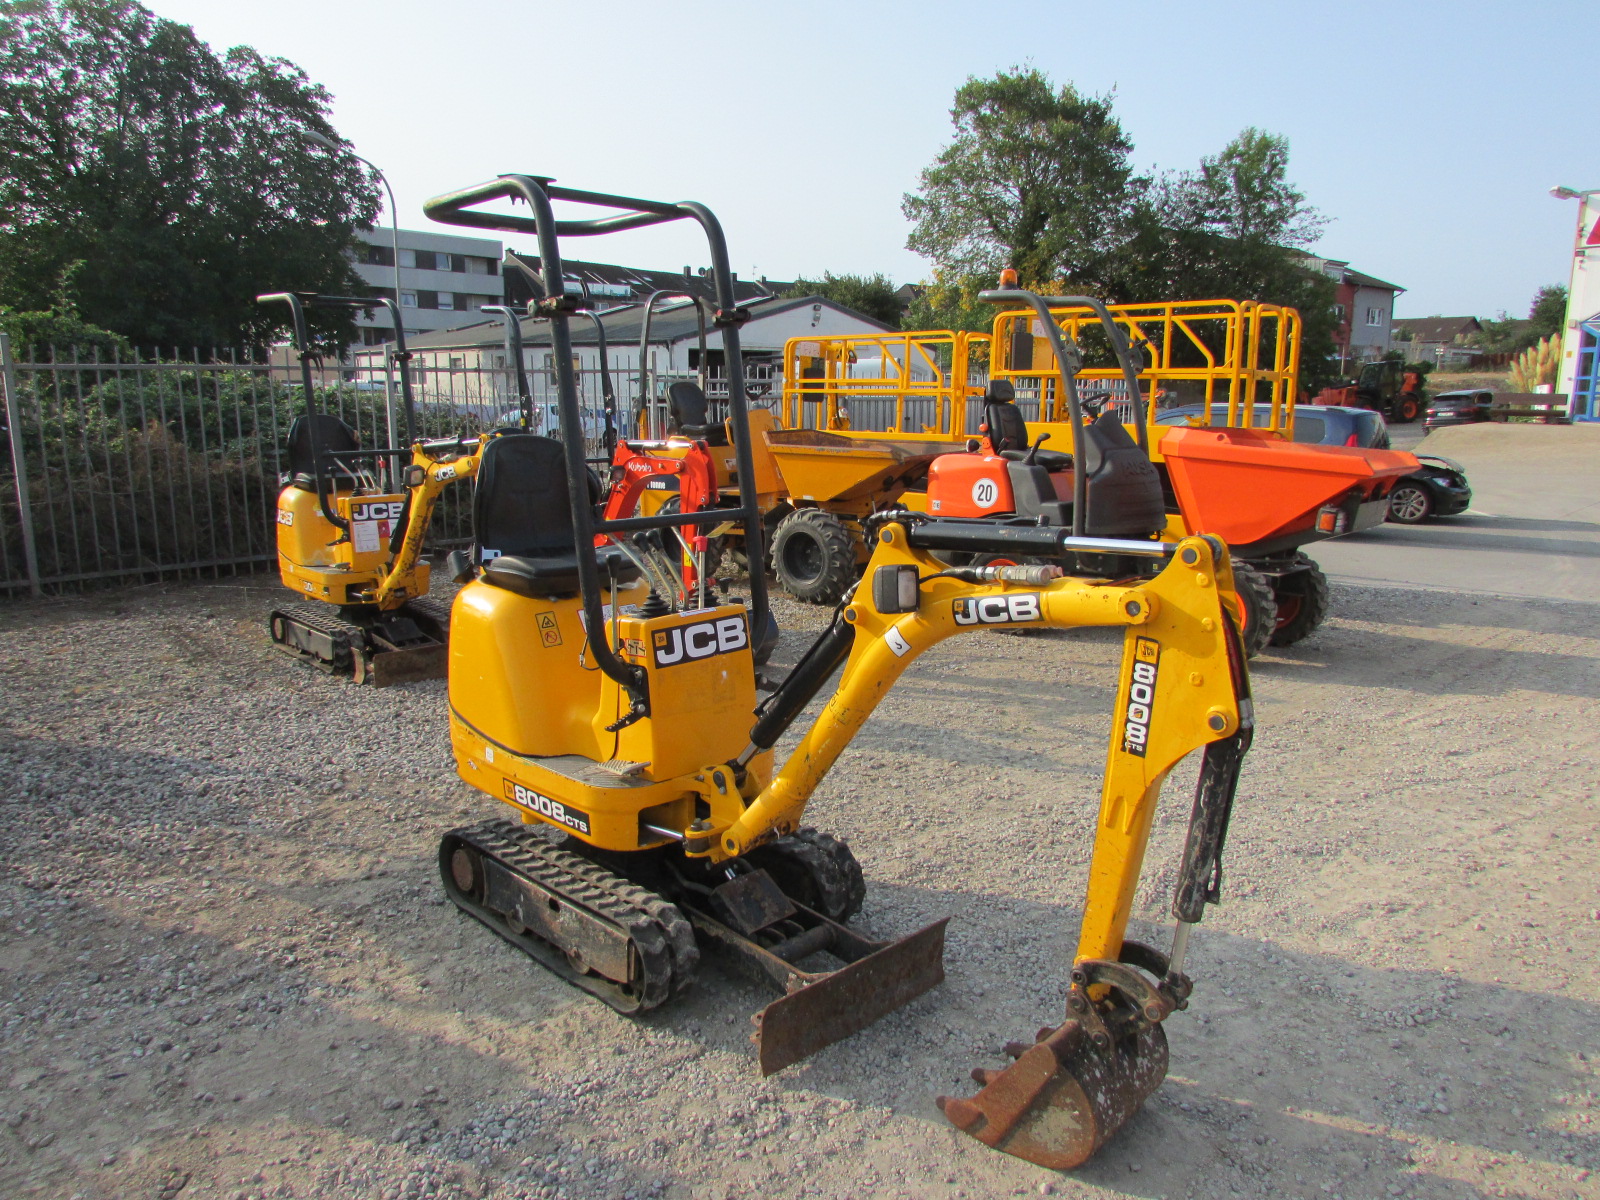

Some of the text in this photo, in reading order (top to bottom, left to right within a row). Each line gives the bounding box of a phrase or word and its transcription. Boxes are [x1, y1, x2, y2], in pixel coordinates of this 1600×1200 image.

[434, 466, 457, 482] JCB
[628, 461, 653, 472] Kubota
[650, 481, 666, 489] tonne
[977, 483, 993, 502] 20
[955, 595, 1040, 625] JCB
[656, 617, 747, 664] JCB
